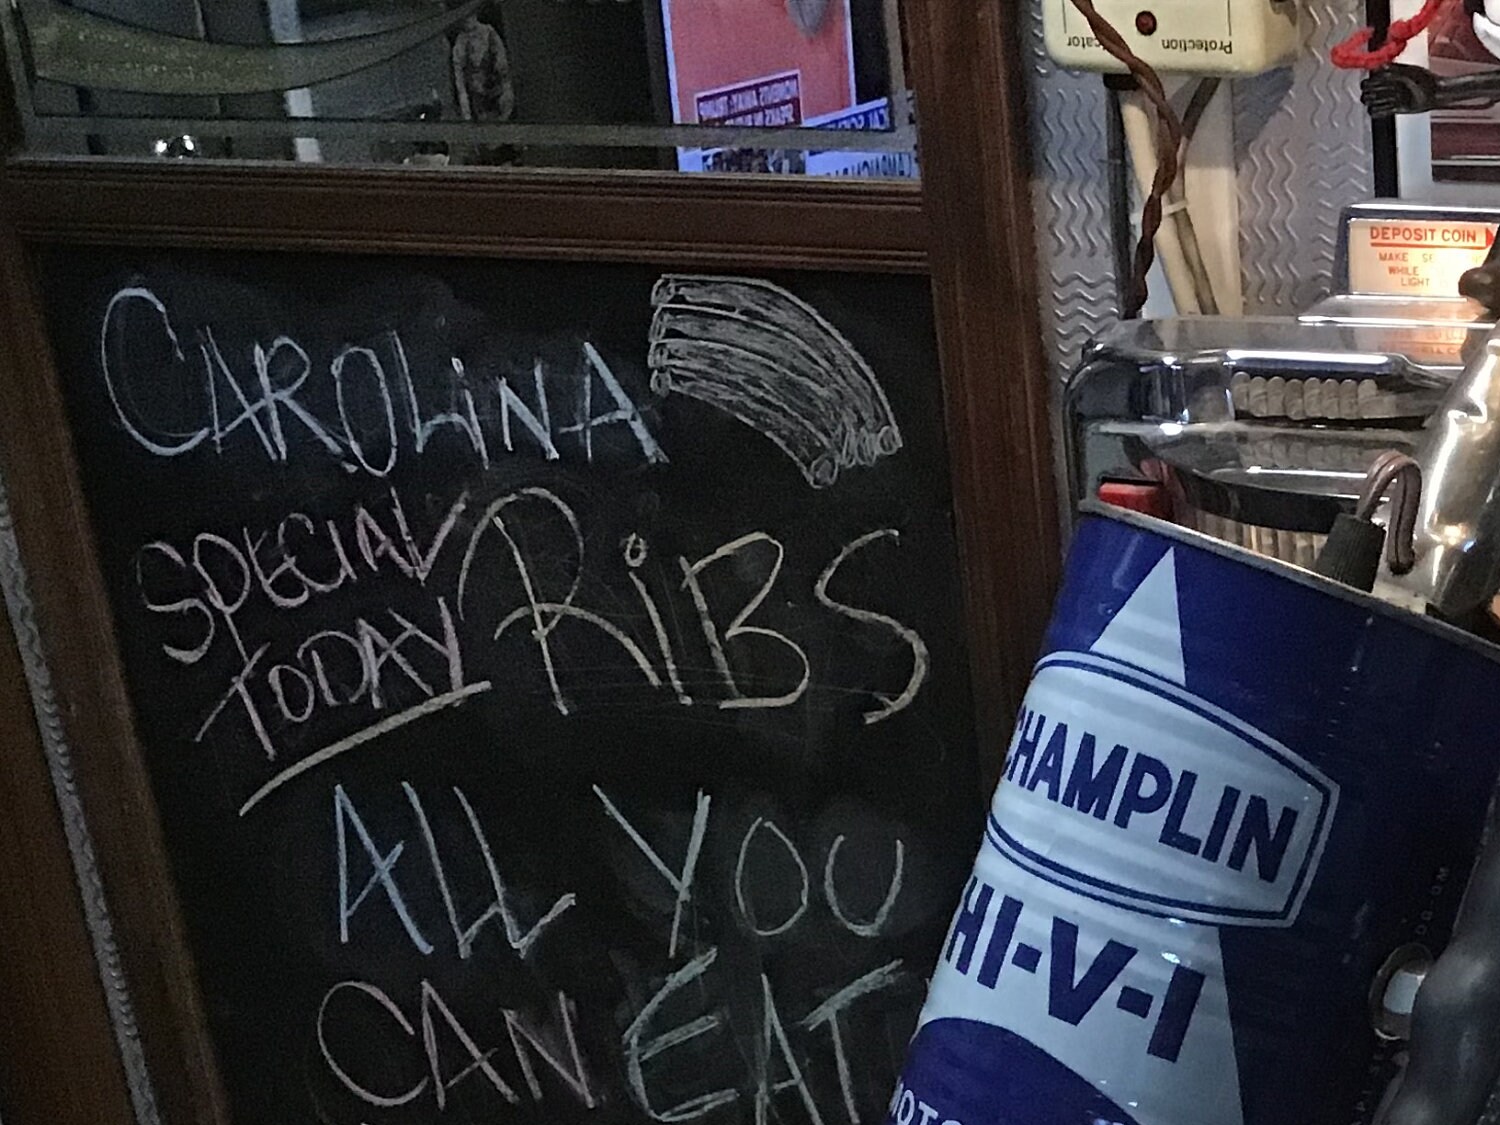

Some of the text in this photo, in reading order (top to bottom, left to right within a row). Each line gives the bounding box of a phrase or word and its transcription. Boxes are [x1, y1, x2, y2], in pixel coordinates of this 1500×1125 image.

[1161, 38, 1233, 55] Protection
[1369, 225, 1477, 244] DEPOSIT COIN
[1378, 251, 1409, 263] MAKE
[1388, 265, 1420, 276] WHILE
[1001, 705, 1299, 884] HAMPLIN
[334, 781, 904, 960] ALL YOU
[316, 978, 596, 1110] CAN
